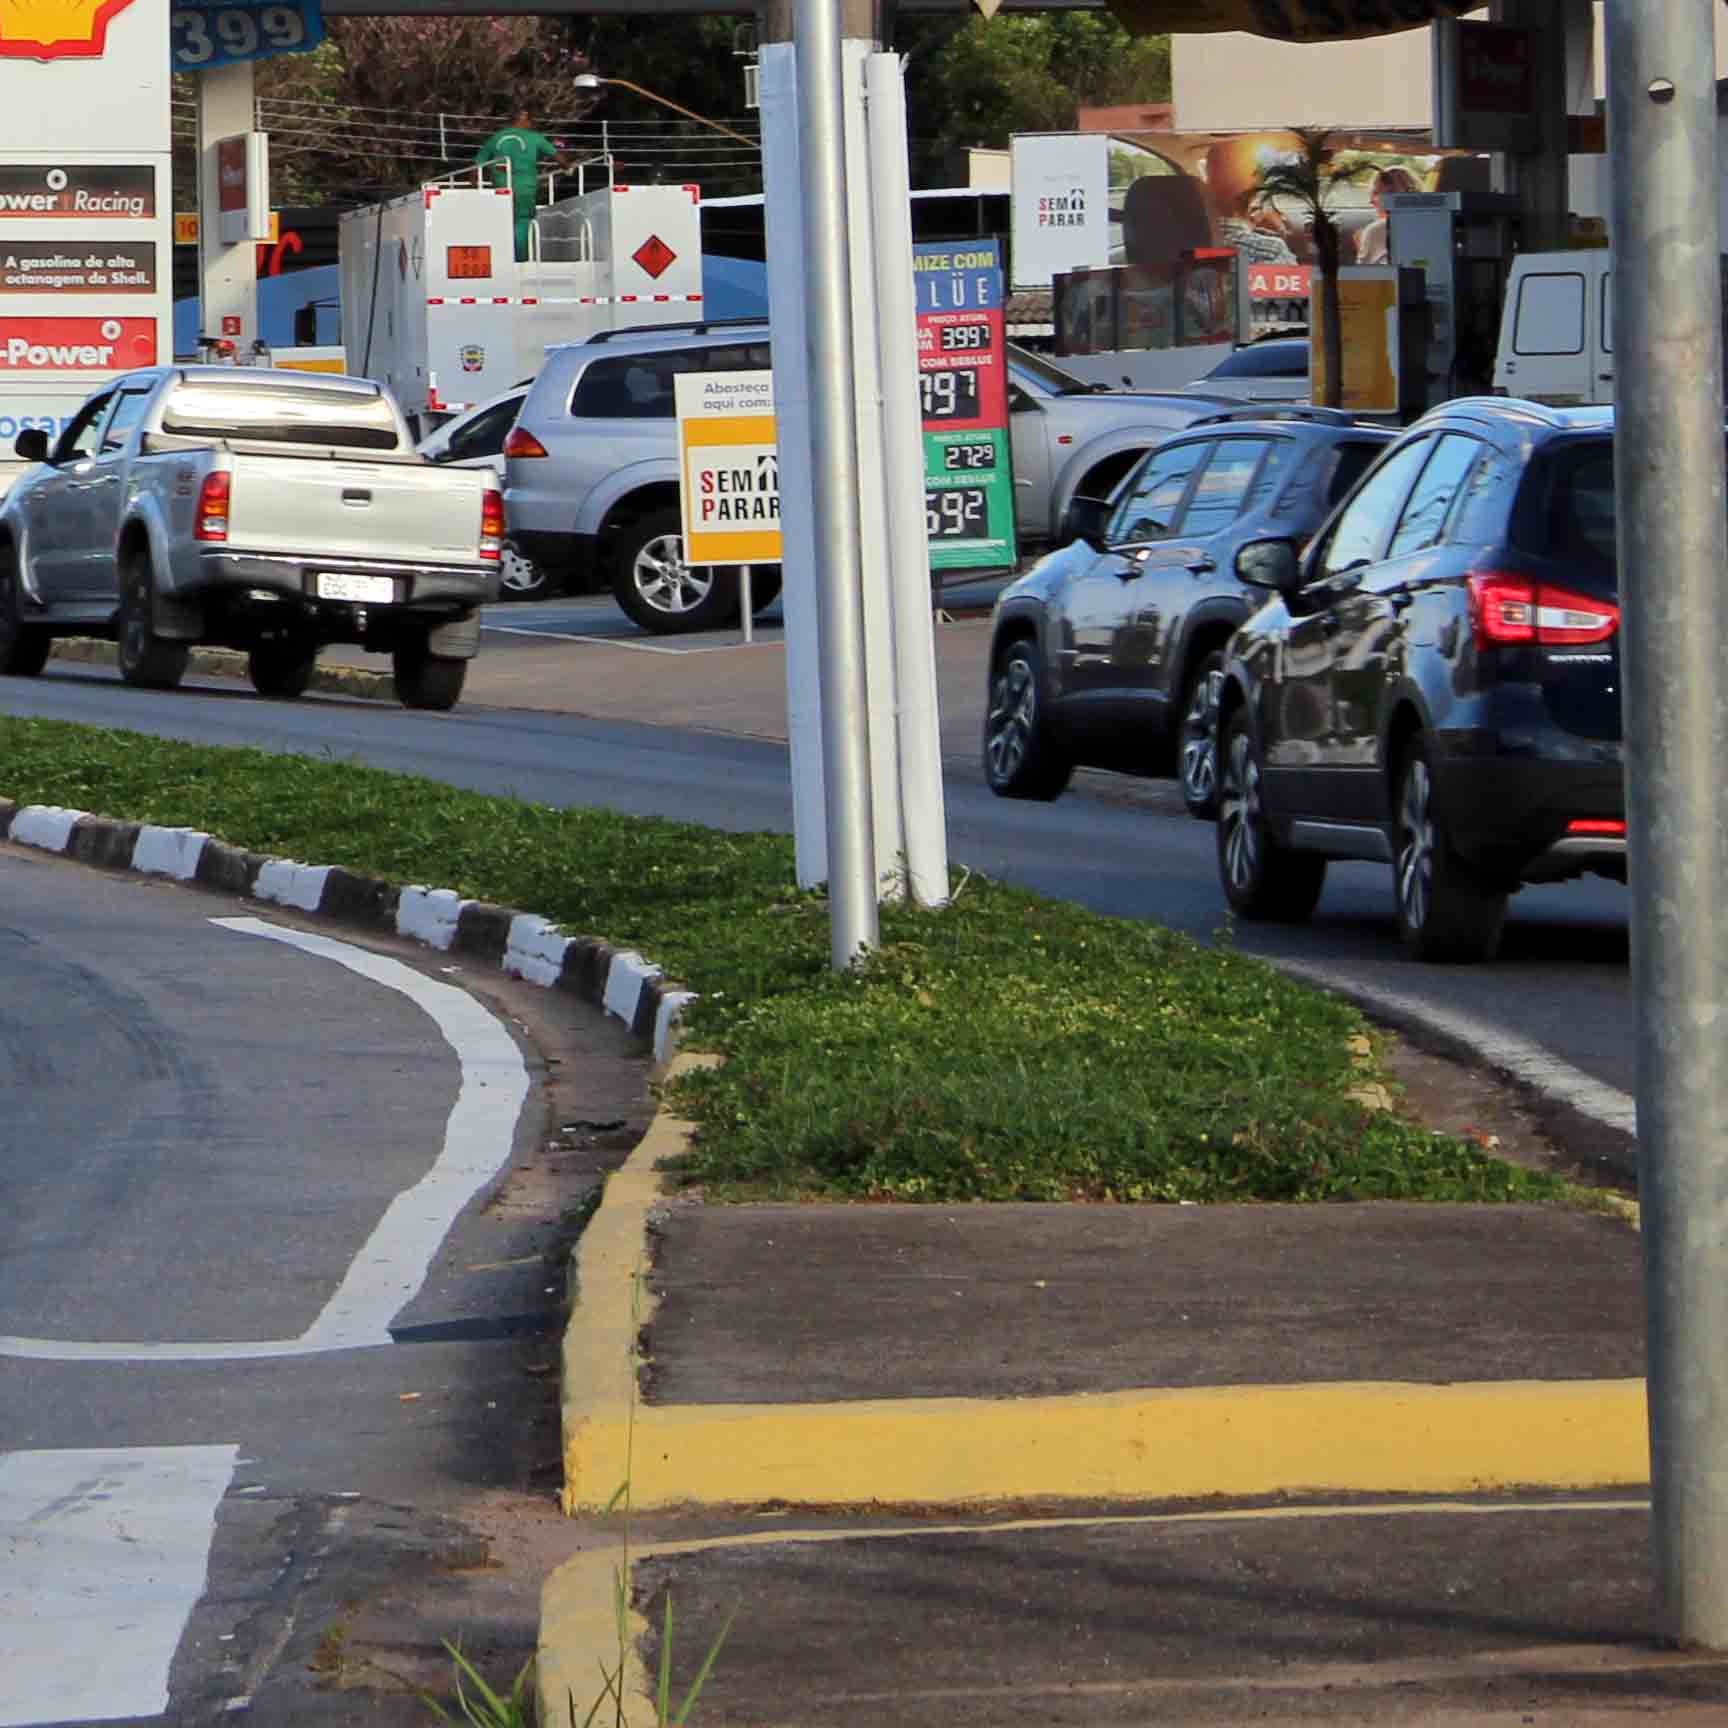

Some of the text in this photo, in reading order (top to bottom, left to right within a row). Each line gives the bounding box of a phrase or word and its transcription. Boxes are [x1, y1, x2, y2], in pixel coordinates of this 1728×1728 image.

[73, 190, 145, 217] Racing
[1039, 197, 1068, 211] SEM
[1039, 213, 1085, 228] PARAR
[4, 255, 136, 271] A gasolina de alta
[954, 252, 994, 270] COM
[4, 273, 84, 287] octanagem
[88, 272, 107, 285] da
[1275, 275, 1302, 292] DE
[704, 382, 769, 395] Abasteça
[704, 396, 734, 411] aqui
[701, 470, 752, 495] SEM
[702, 496, 781, 522] PARAR
